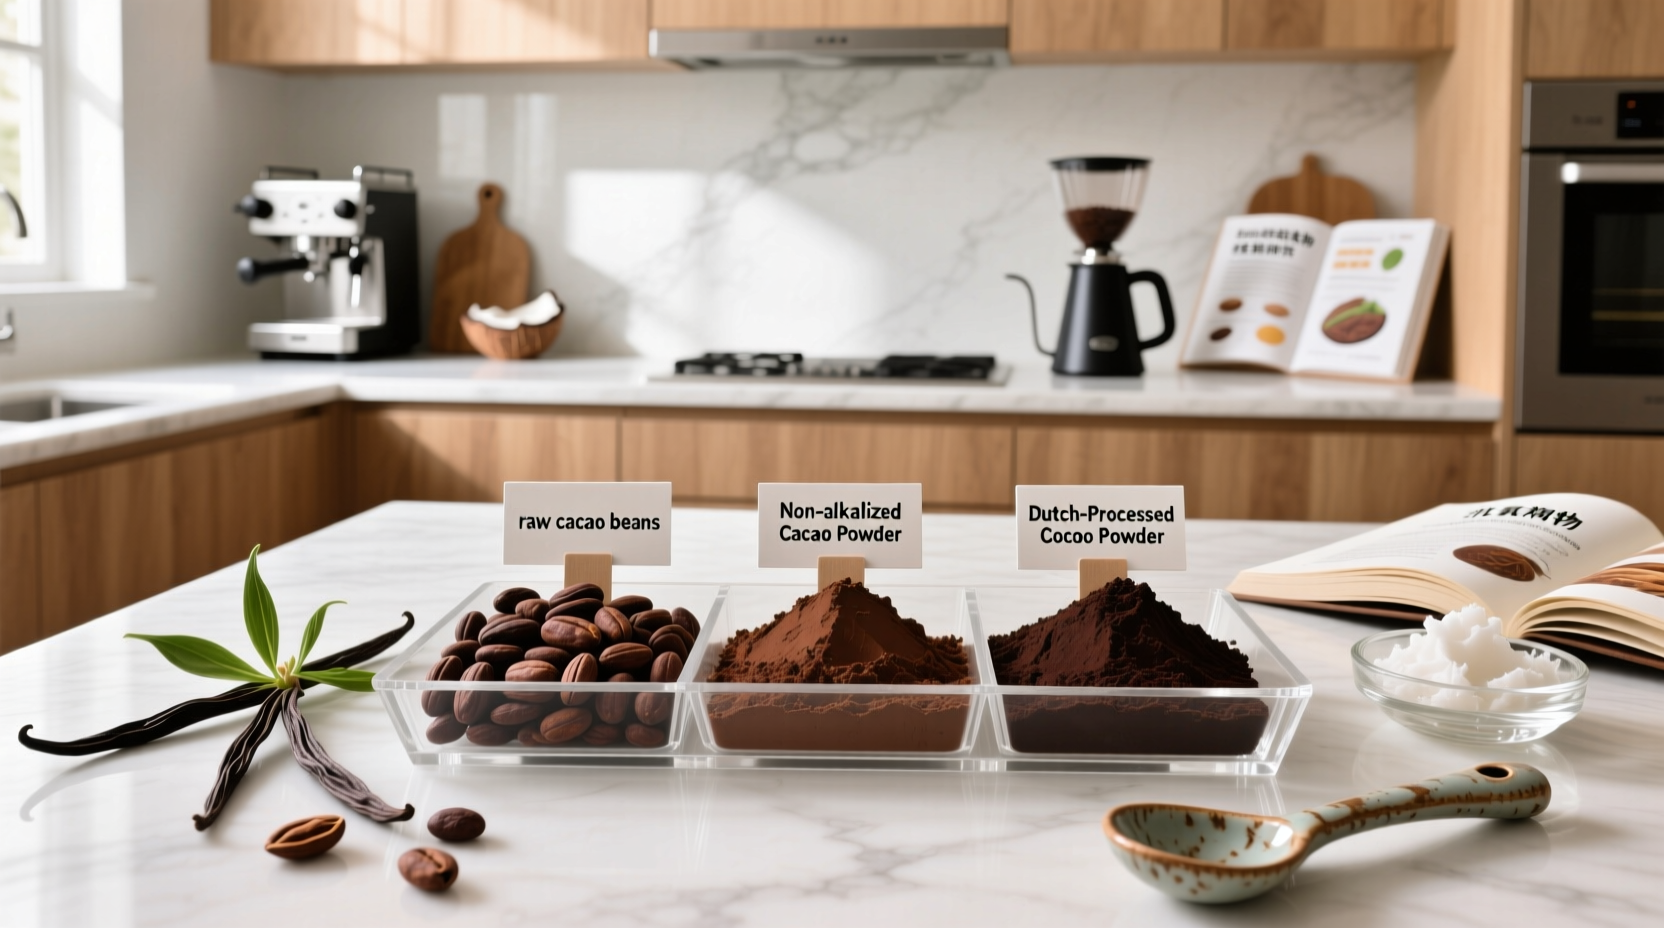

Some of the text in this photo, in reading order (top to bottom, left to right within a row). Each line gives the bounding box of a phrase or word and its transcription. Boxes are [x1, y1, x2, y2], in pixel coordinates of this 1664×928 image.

[780, 501, 903, 519] Non-alkalized
[1029, 504, 1176, 522] Dutch-Processed
[519, 511, 661, 530] raw cacao beans
[780, 524, 904, 542] Cacao Powder
[1041, 526, 1166, 544] Cocoo Powder
